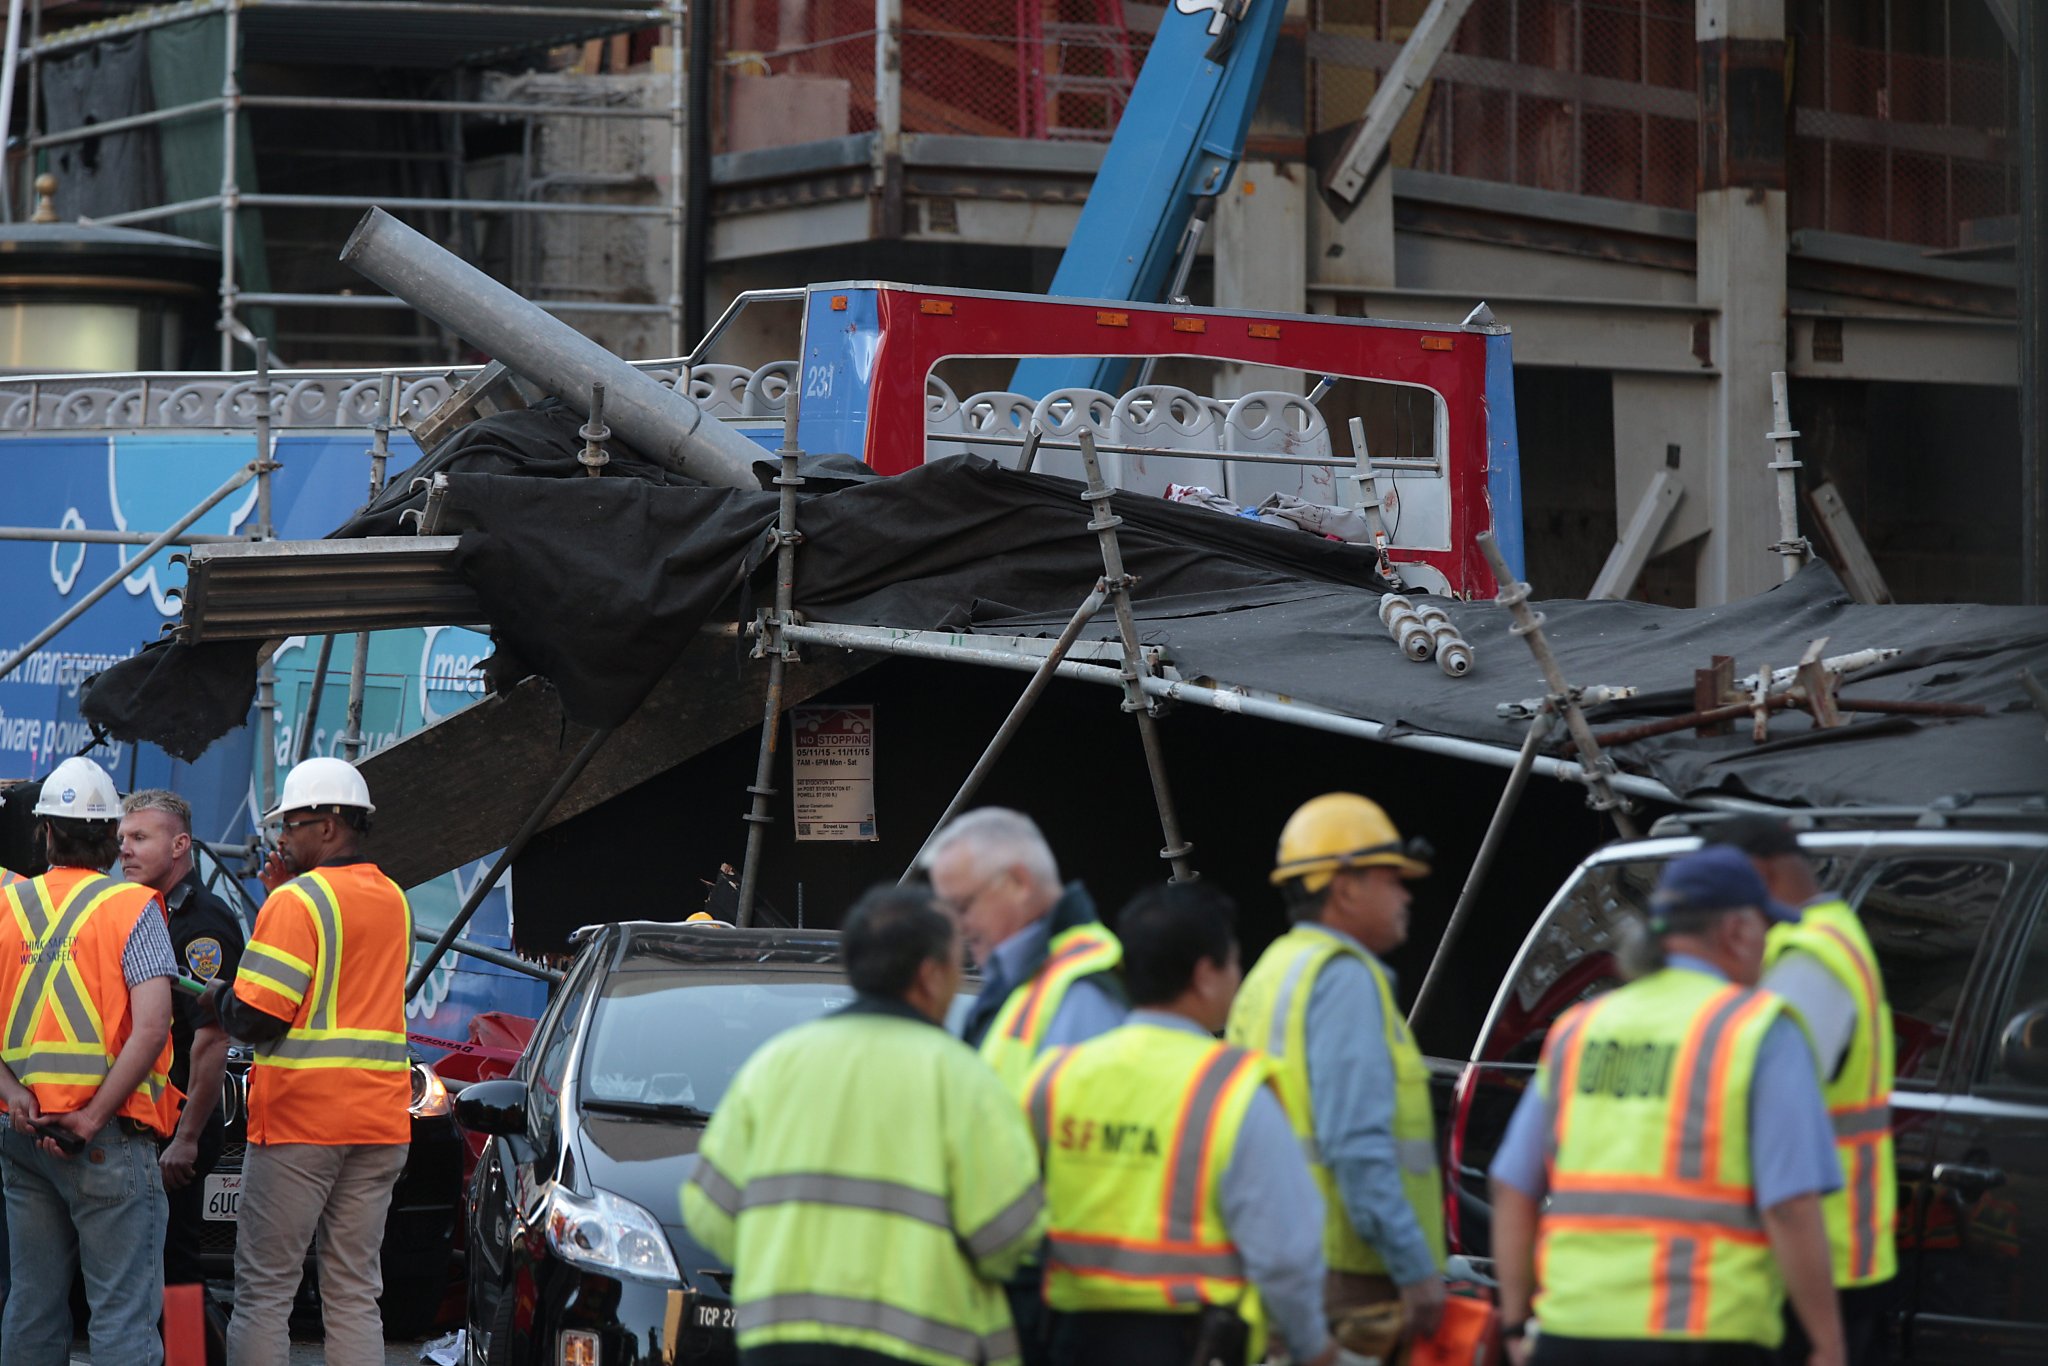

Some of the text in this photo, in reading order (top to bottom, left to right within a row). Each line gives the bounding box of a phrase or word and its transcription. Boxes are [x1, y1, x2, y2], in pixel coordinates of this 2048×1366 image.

[807, 363, 834, 398] 231
[24, 648, 135, 698] managem
[274, 709, 326, 767] als
[800, 735, 869, 744] NO STOPPING
[21, 936, 79, 952] THINK SAFETY
[21, 950, 78, 965] WORK SAFELY
[699, 1305, 720, 1327] TCP
